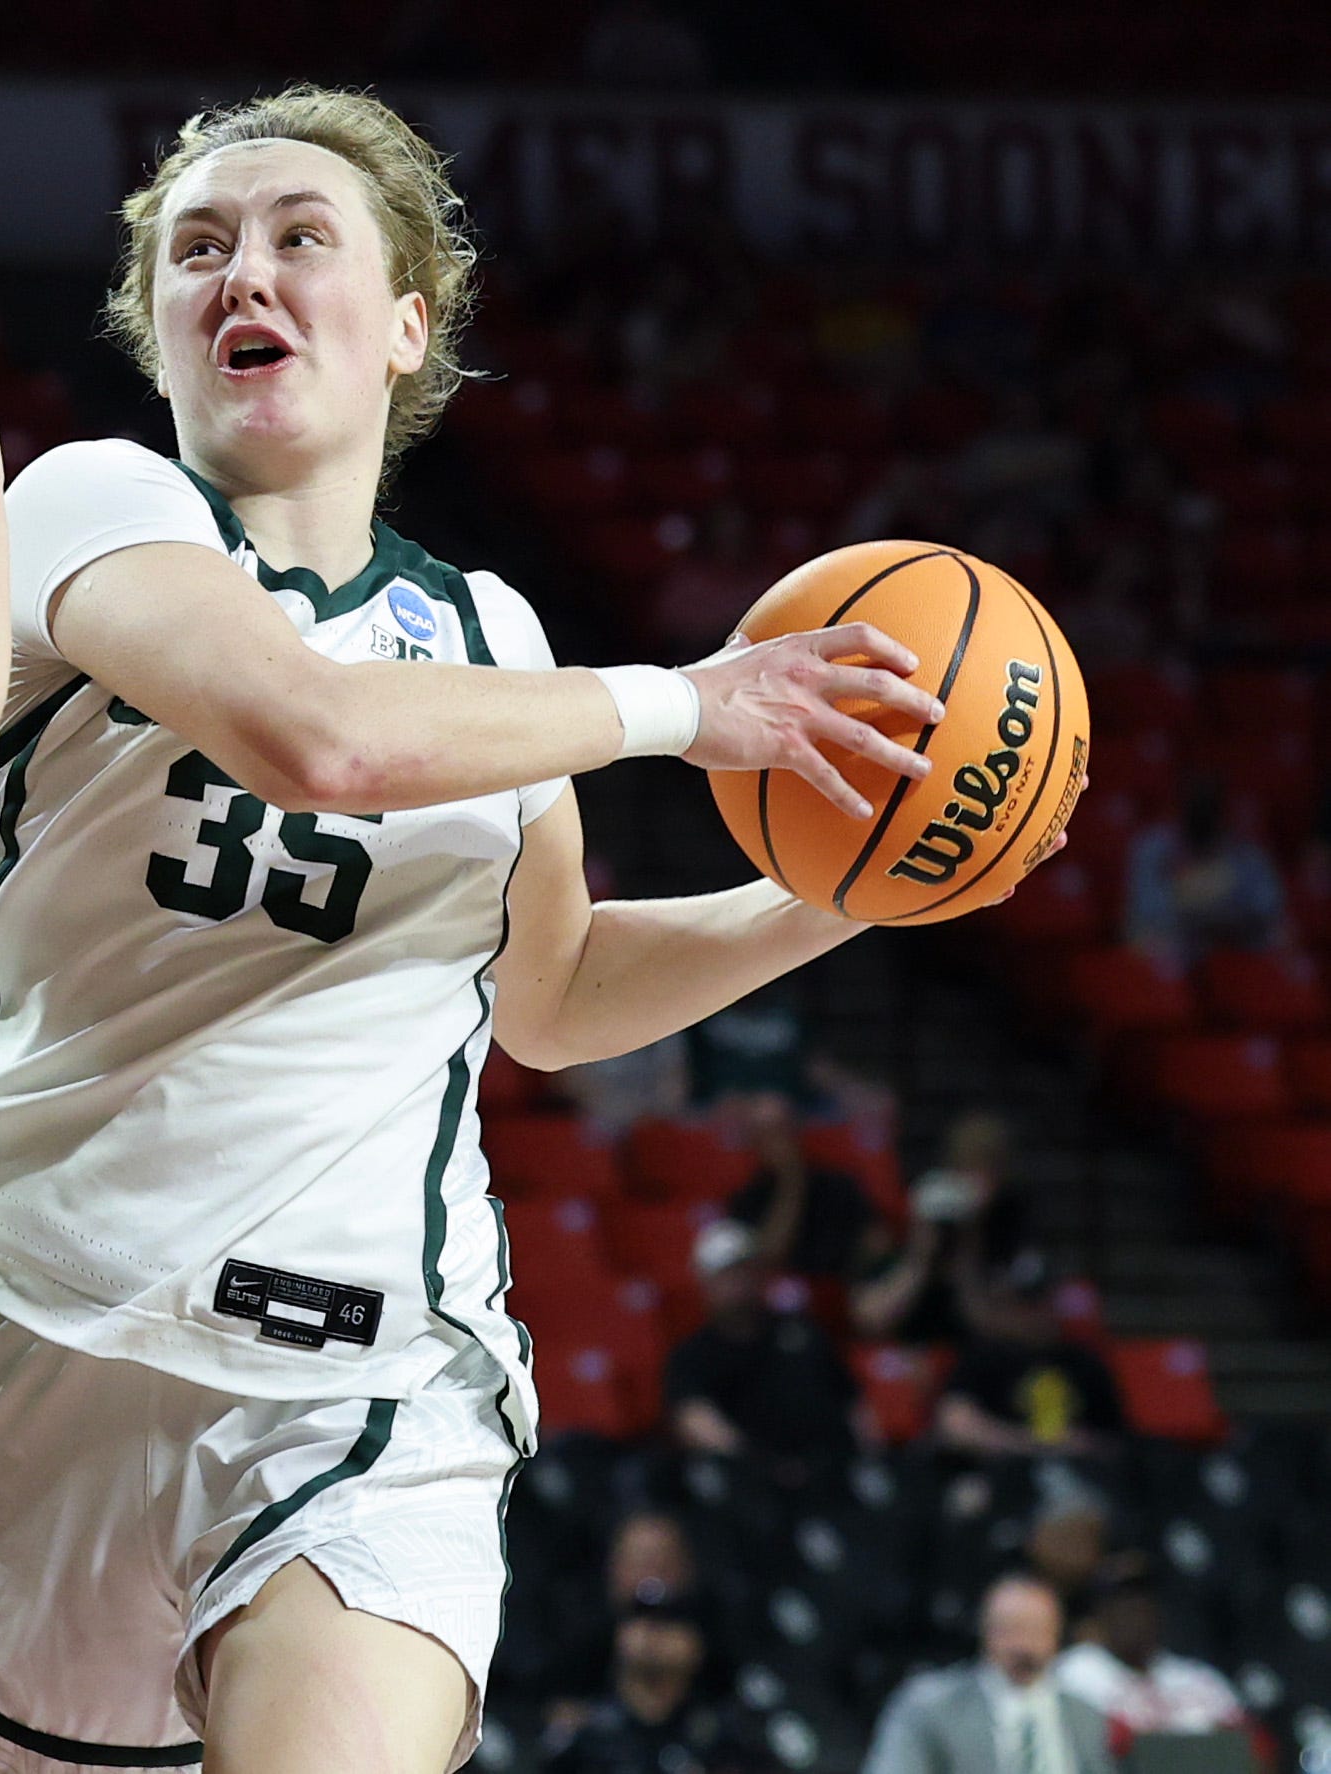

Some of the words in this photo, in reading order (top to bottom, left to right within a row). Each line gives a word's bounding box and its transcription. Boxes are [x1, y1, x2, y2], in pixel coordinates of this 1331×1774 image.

[395, 603, 435, 633] NCAA
[885, 658, 1043, 886] Wilson
[995, 797, 1018, 833] EVO
[1016, 756, 1035, 794] NXT
[146, 748, 383, 945] 35
[338, 1302, 367, 1326] 46
